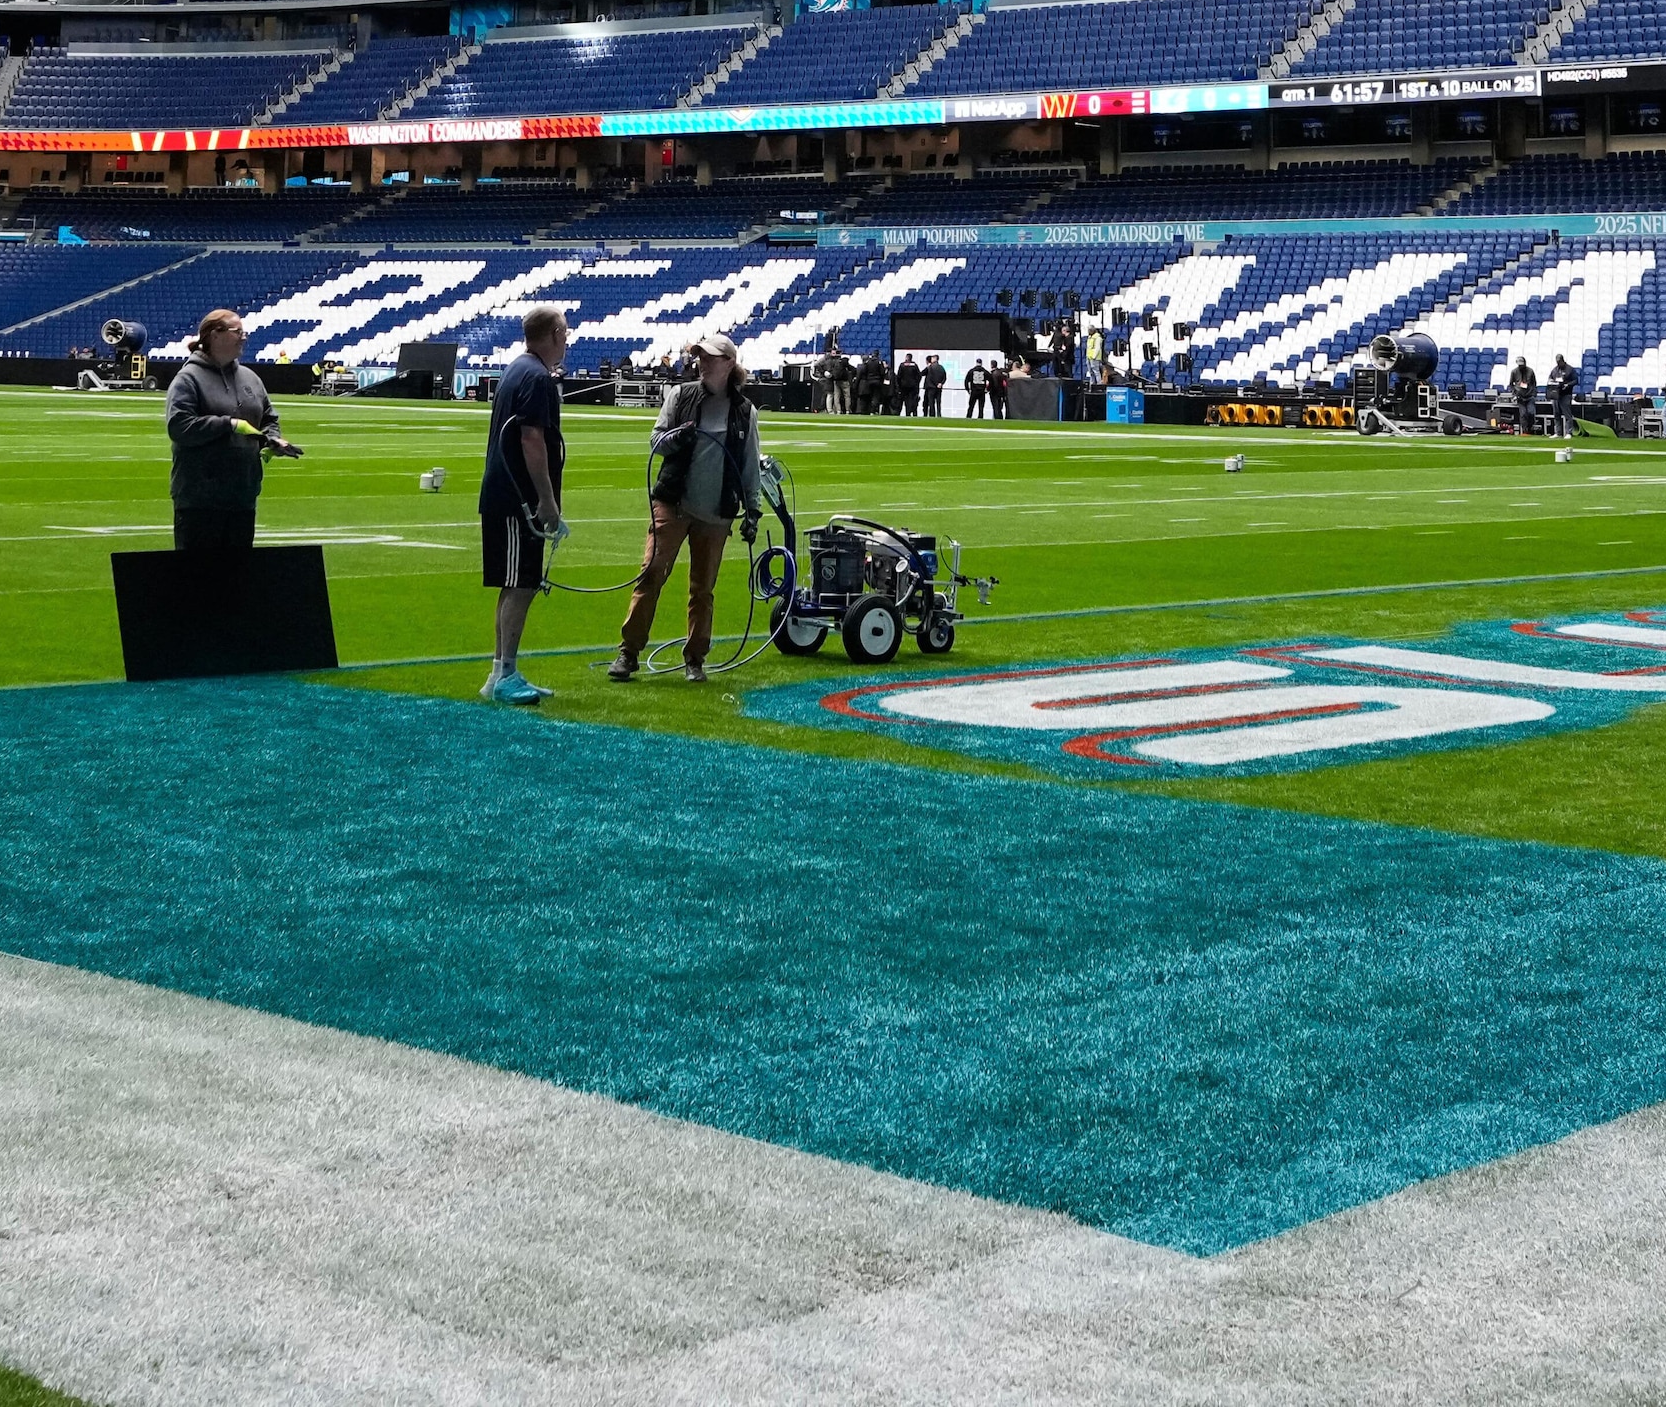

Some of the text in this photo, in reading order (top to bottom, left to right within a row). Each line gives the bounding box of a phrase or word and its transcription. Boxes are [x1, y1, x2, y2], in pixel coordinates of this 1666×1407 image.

[1282, 82, 1384, 103] QTR 1 61:57
[1399, 76, 1535, 99] 1ST & 10 BALL ON 25
[971, 100, 1027, 118] NetApp
[1088, 95, 1101, 115] 0
[347, 120, 521, 144] WASHINGTON COMMANDERS
[1045, 224, 1205, 243] 2025 NFL MADRID GAME
[1595, 216, 1636, 234] 2025
[883, 228, 978, 244] MIAMI DOLPHINS
